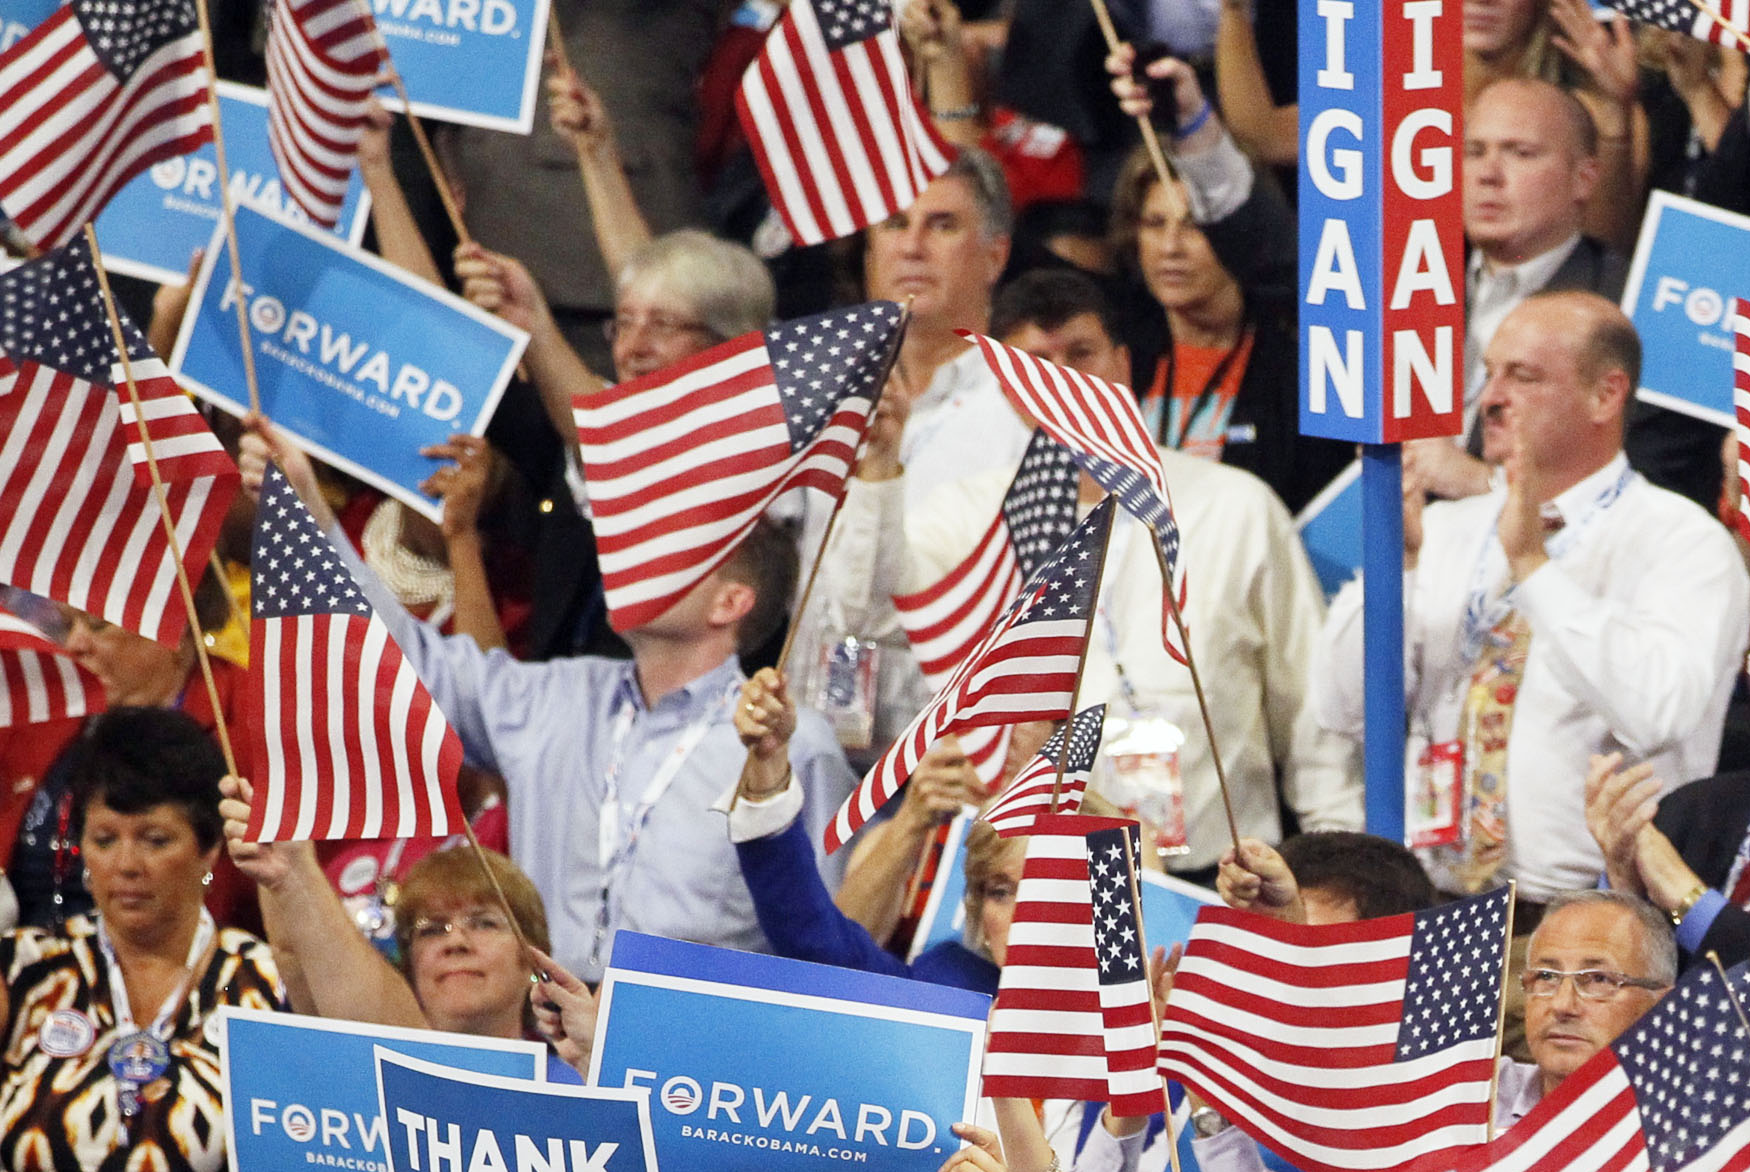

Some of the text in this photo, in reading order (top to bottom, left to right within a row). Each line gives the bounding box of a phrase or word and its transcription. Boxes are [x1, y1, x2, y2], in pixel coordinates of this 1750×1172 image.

[1305, 0, 1366, 419] IGAN
[1389, 0, 1456, 418] IGAN
[219, 278, 462, 430] FORWARD.
[251, 1098, 387, 1153] FORW
[623, 1069, 941, 1153] FORWARD.
[681, 1125, 867, 1162] BARACKOBAMA.COM
